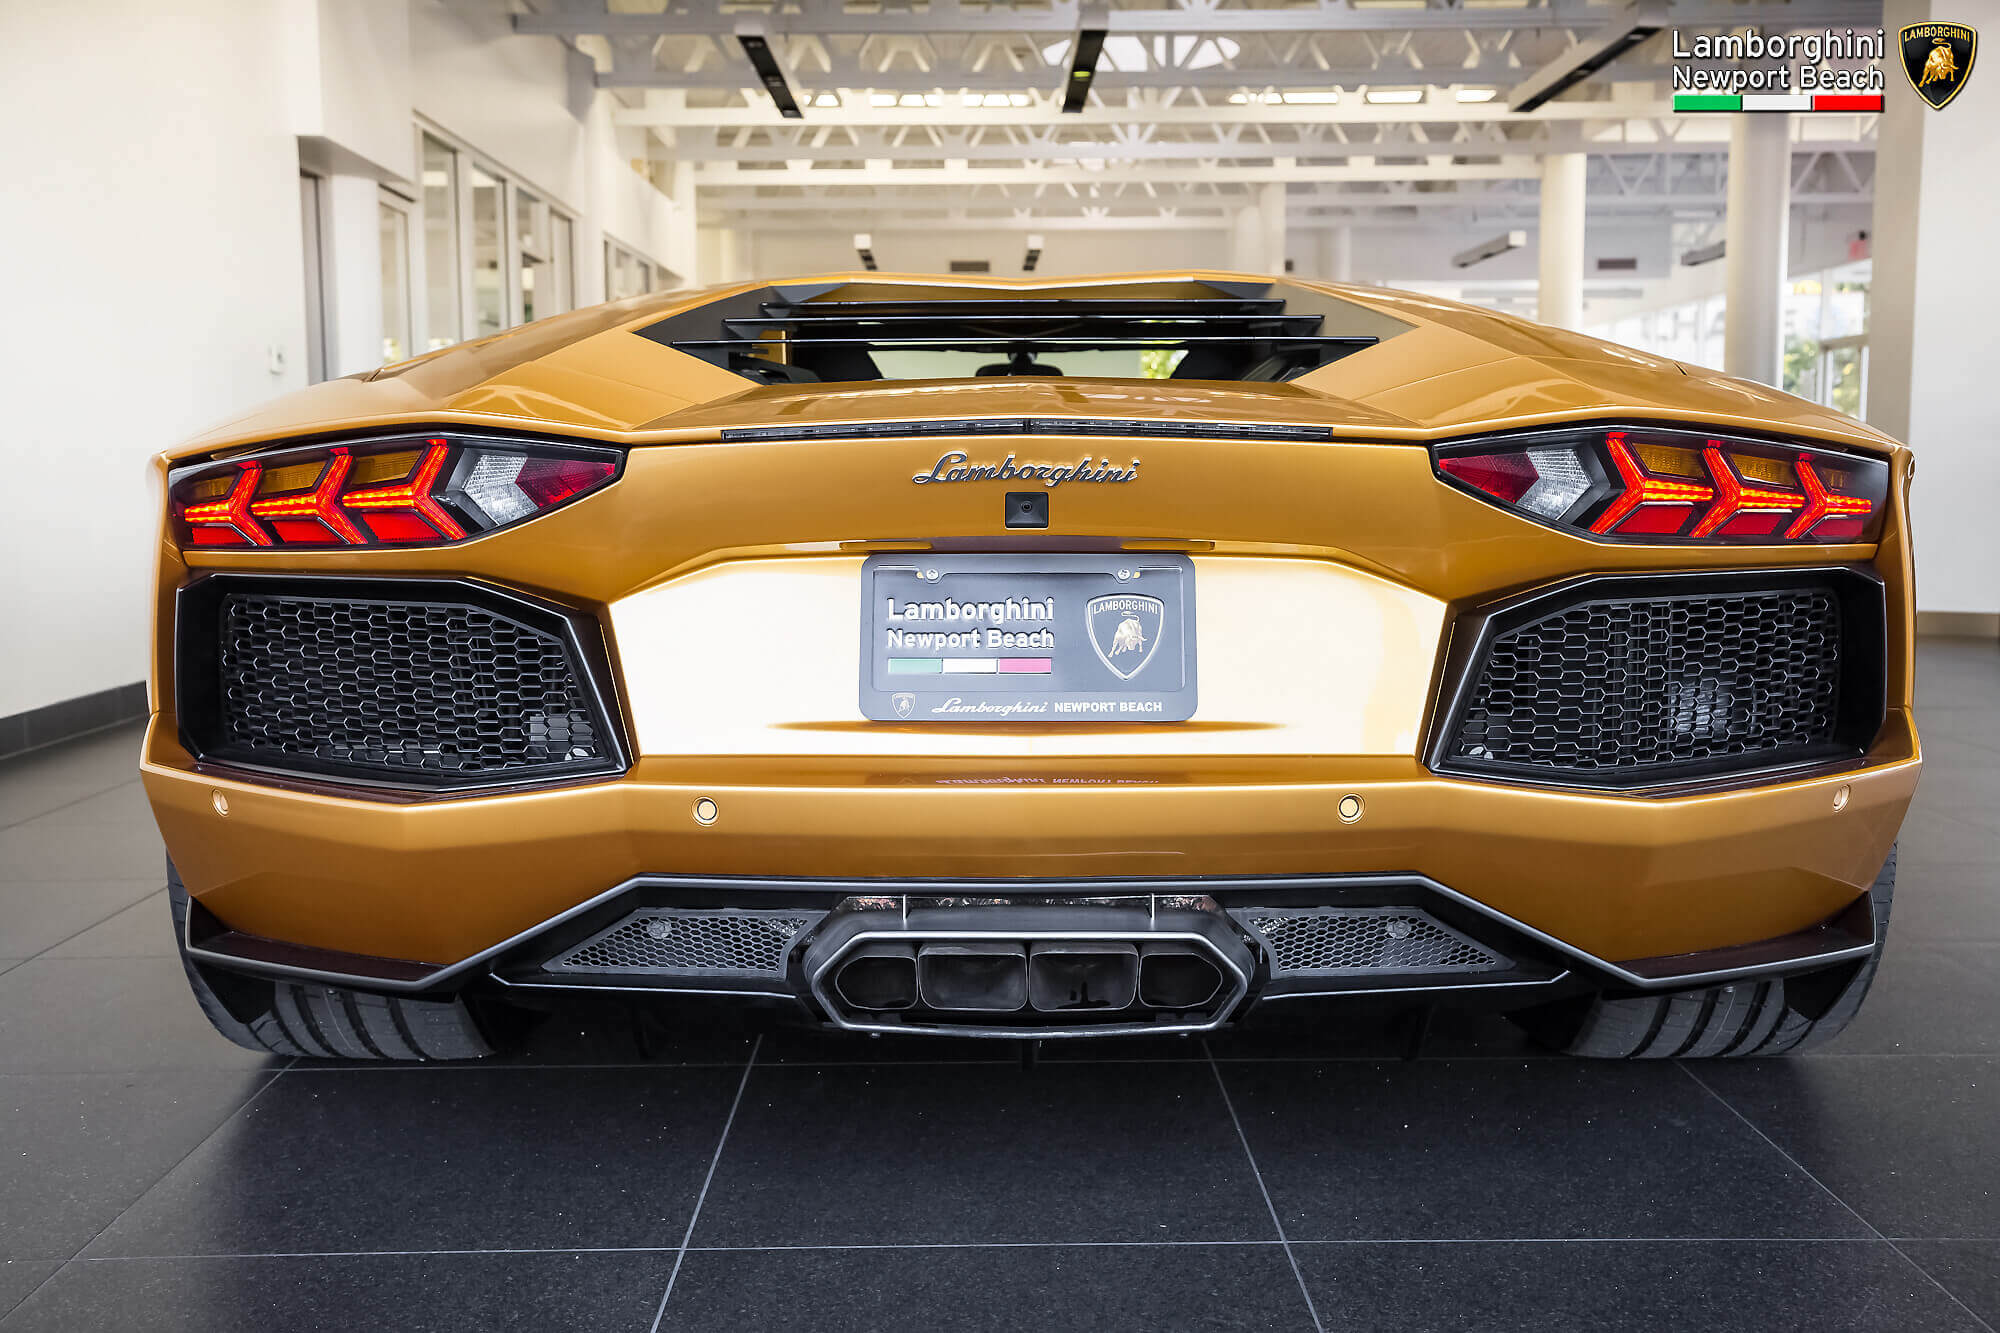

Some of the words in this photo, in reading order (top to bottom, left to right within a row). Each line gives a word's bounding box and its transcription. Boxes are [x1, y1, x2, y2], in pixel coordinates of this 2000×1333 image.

[912, 450, 1140, 487] Lamborghini
[887, 597, 1054, 625] Lamborghini
[1093, 599, 1159, 616] LAMBORGHINI
[886, 628, 981, 652] Newport
[987, 627, 1054, 649] Beach
[931, 697, 1049, 717] Lamborghini
[1054, 701, 1116, 714] NEWPORT
[1119, 701, 1162, 713] BEACH
